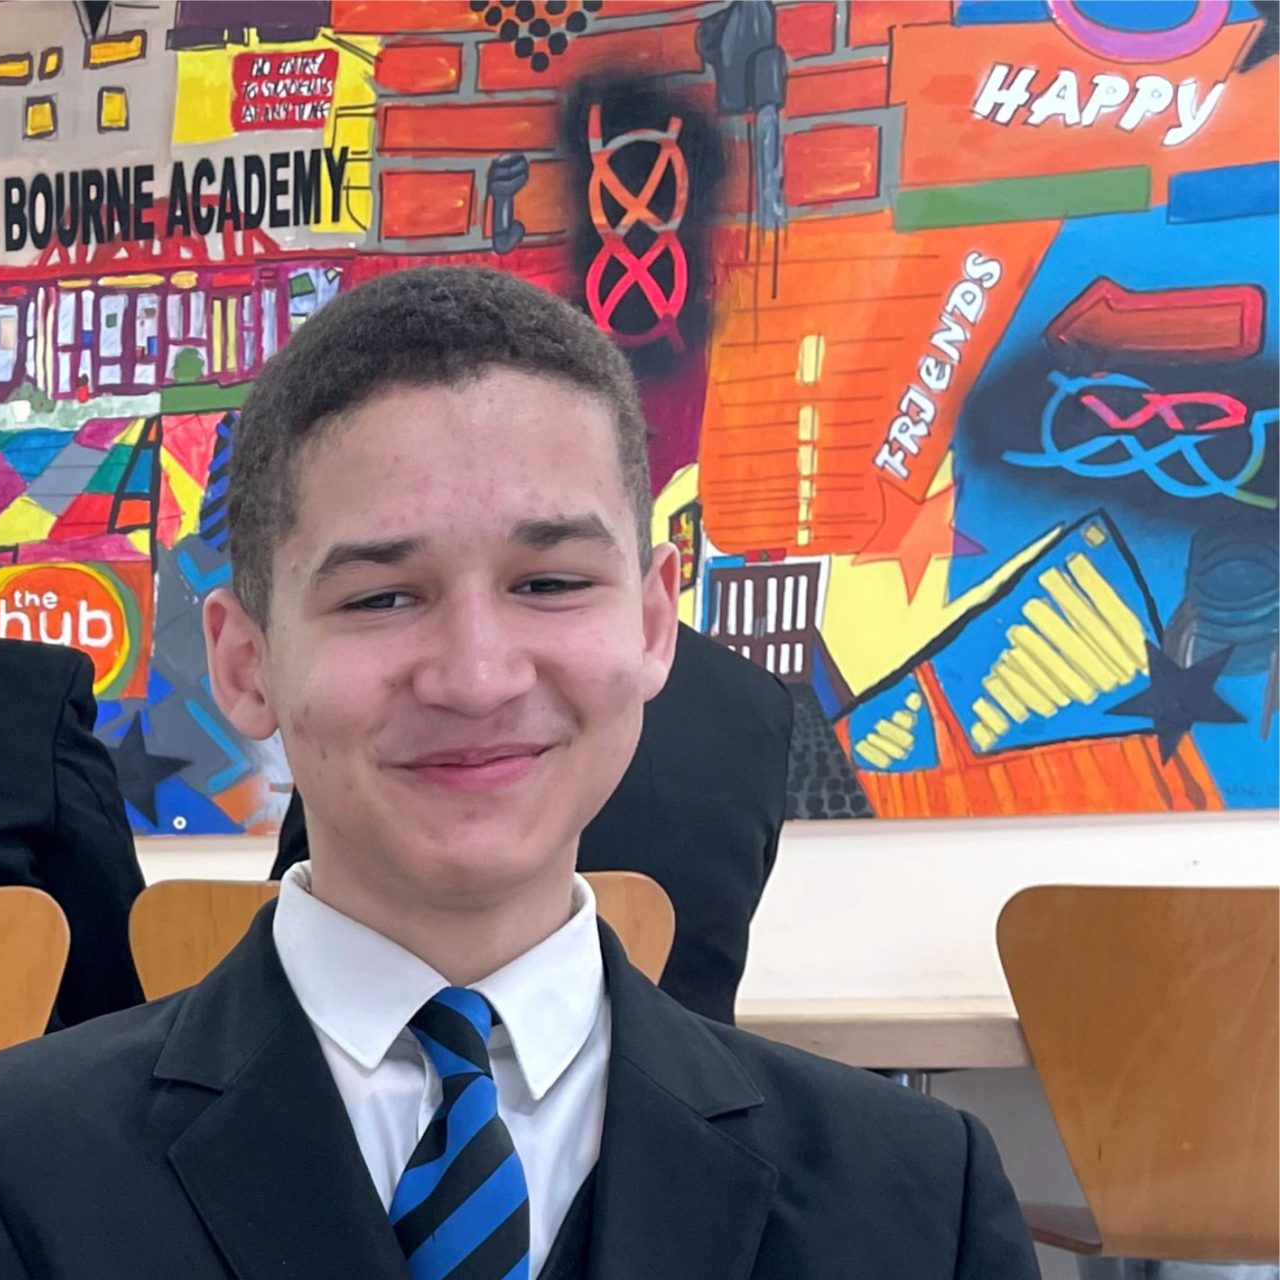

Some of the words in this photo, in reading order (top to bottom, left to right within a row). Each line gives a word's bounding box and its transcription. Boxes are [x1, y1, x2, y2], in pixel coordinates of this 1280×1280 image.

[4, 164, 155, 252] BOURNE
[166, 146, 350, 239] ACADEMY
[13, 589, 59, 610] the
